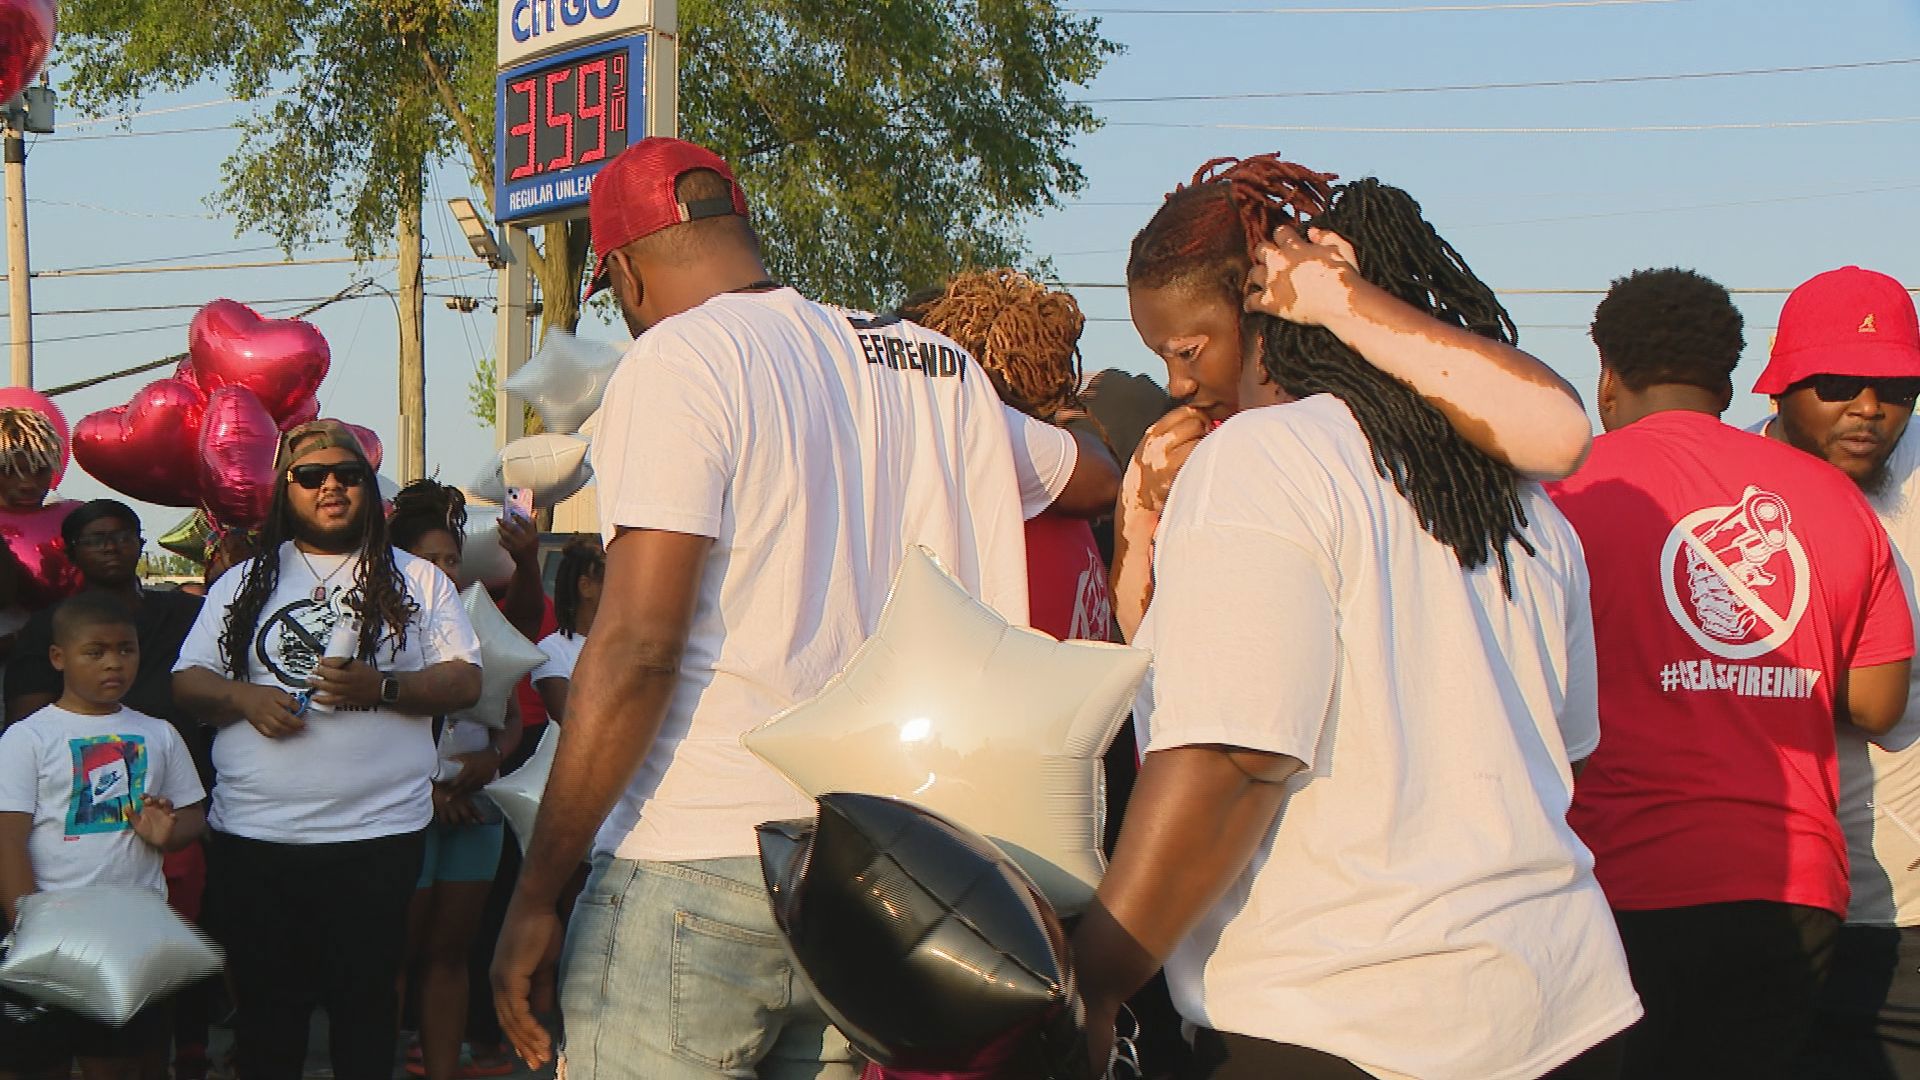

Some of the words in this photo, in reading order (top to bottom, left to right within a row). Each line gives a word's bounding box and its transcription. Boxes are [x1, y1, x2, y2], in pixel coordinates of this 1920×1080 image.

[510, 59, 606, 180] 3.59
[509, 182, 553, 211] REGULAR
[555, 174, 597, 200] UNLEA
